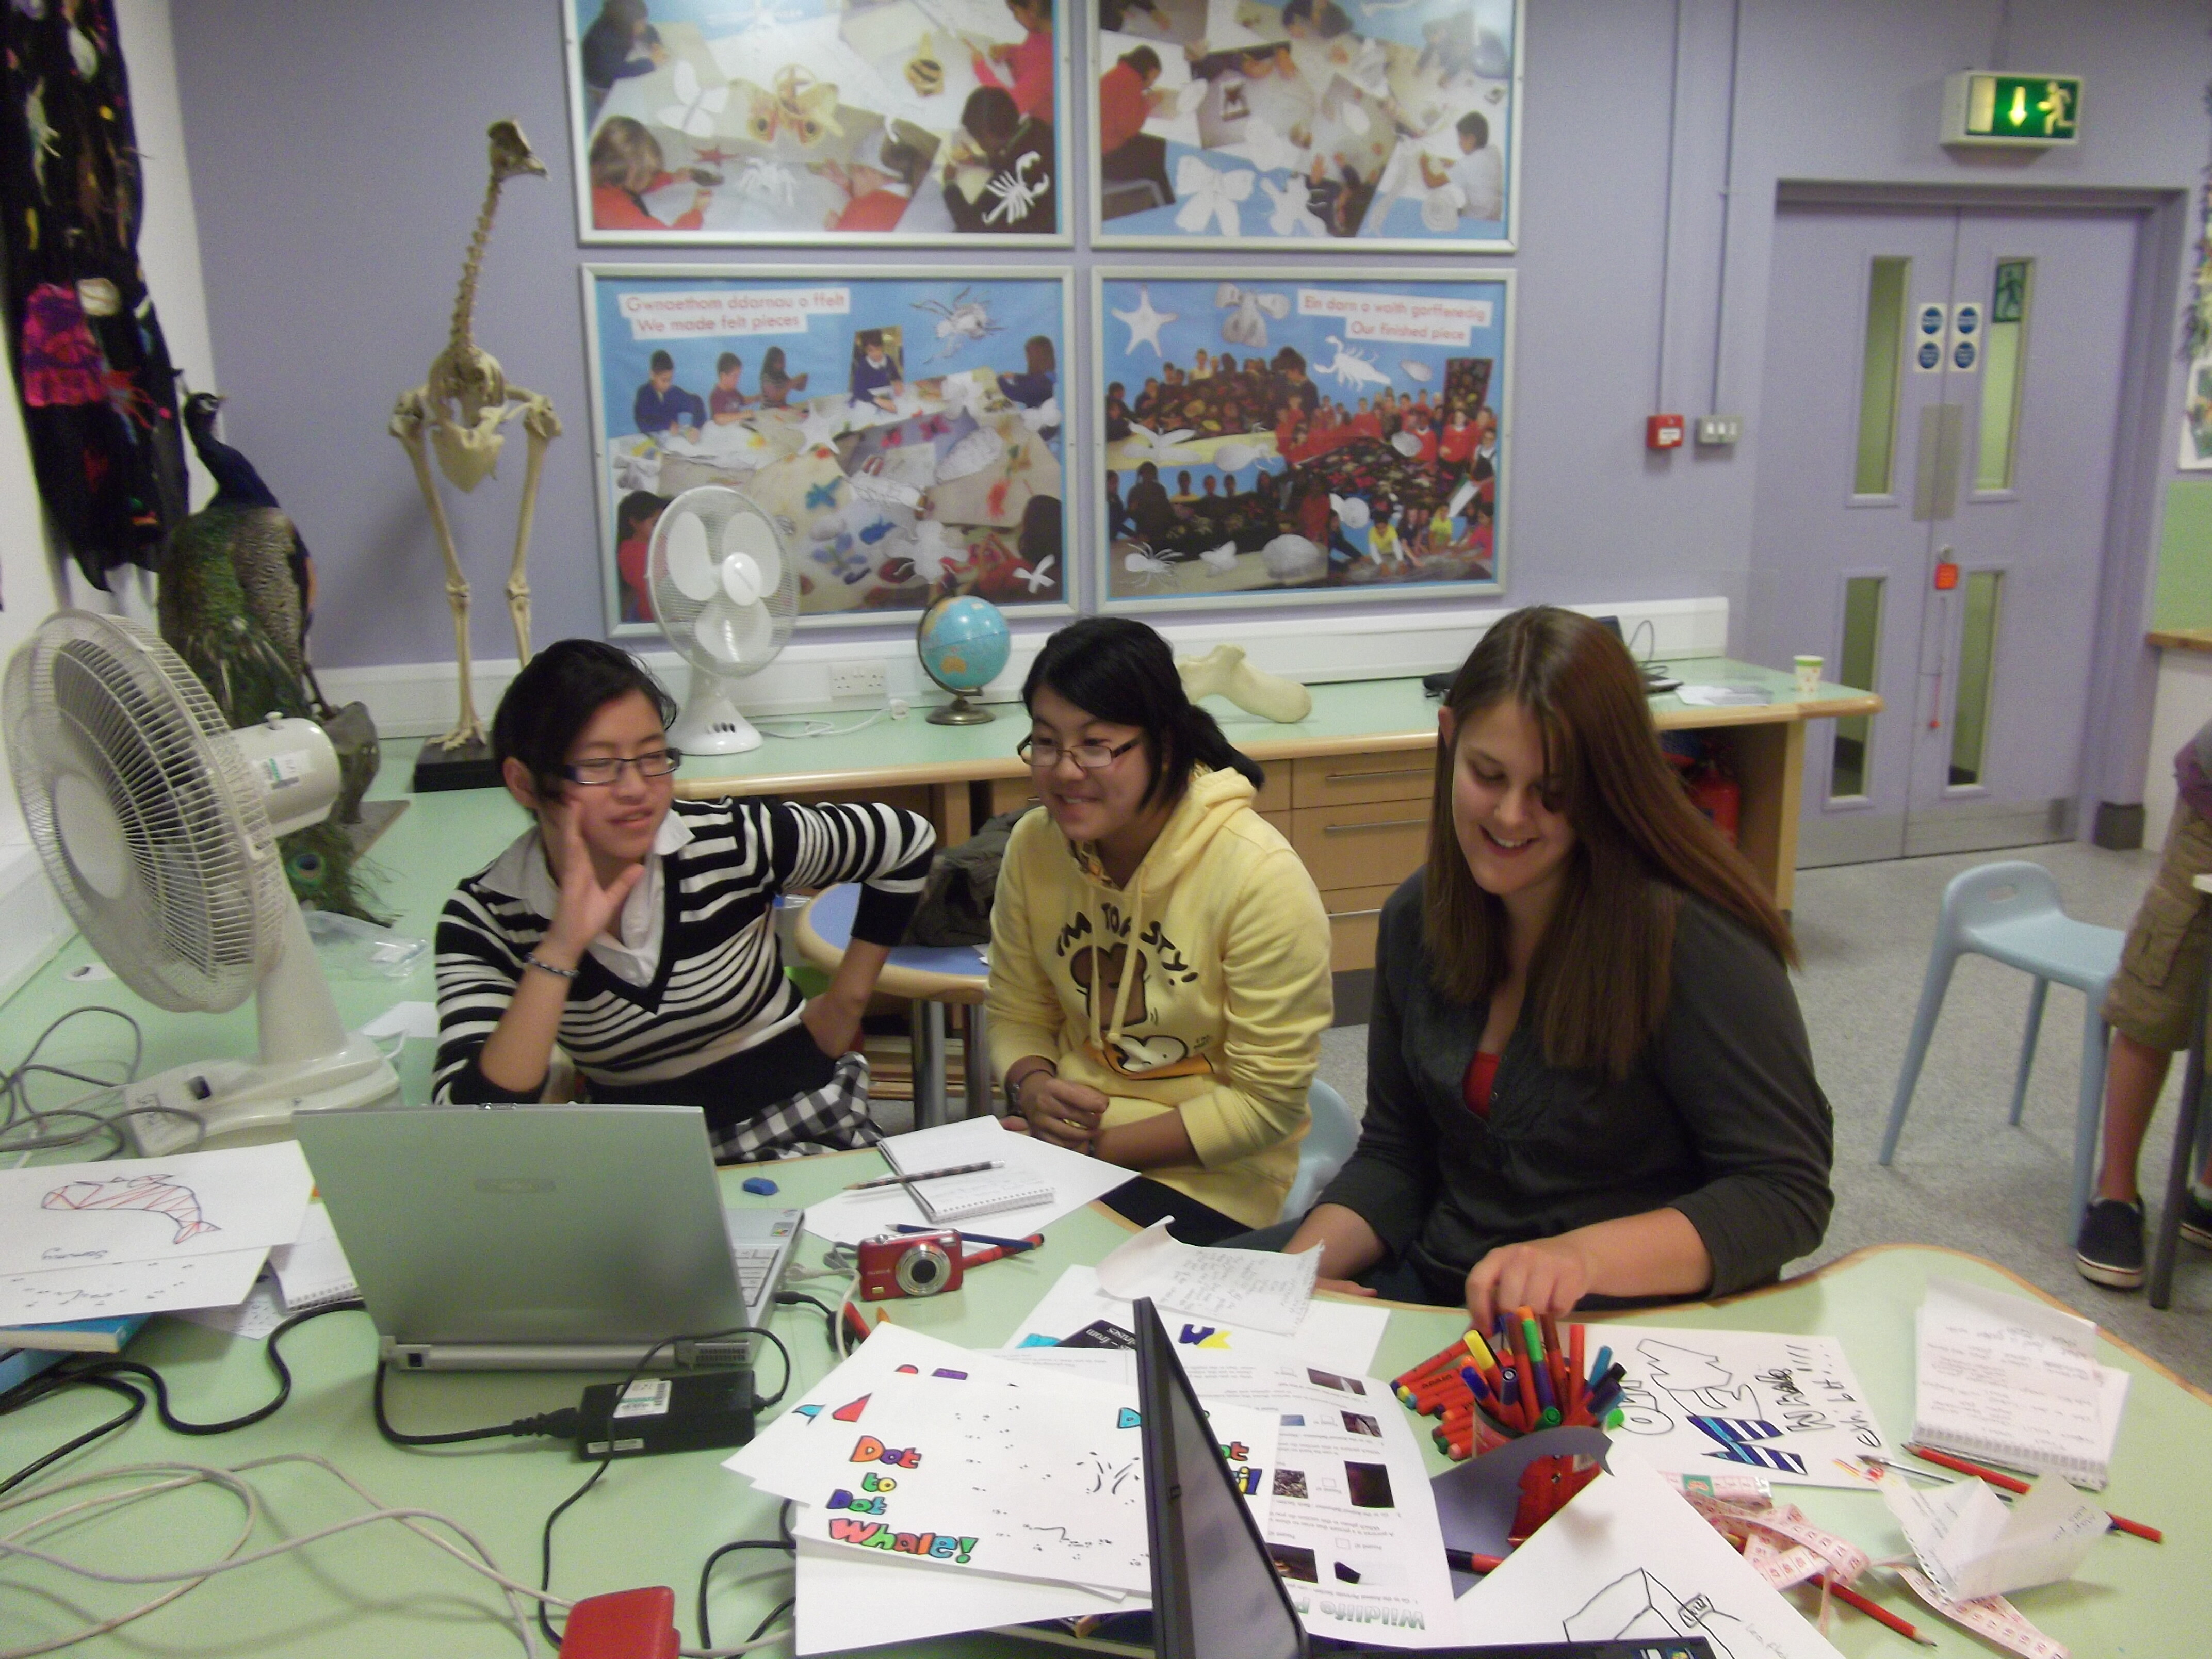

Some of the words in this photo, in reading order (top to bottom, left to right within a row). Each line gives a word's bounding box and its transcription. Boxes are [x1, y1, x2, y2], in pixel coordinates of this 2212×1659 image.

[636, 319, 665, 333] We
[670, 316, 715, 330] made
[721, 314, 747, 330] felt
[752, 314, 799, 331] pieces
[1350, 320, 1375, 335] Our
[1380, 321, 1428, 337] finished
[1431, 328, 1467, 340] piece
[849, 1435, 922, 1469] Dot
[861, 1472, 897, 1492] to
[826, 1488, 887, 1515] Dot
[828, 1518, 979, 1564] Whale!
[1319, 1600, 1426, 1631] Wildlife
